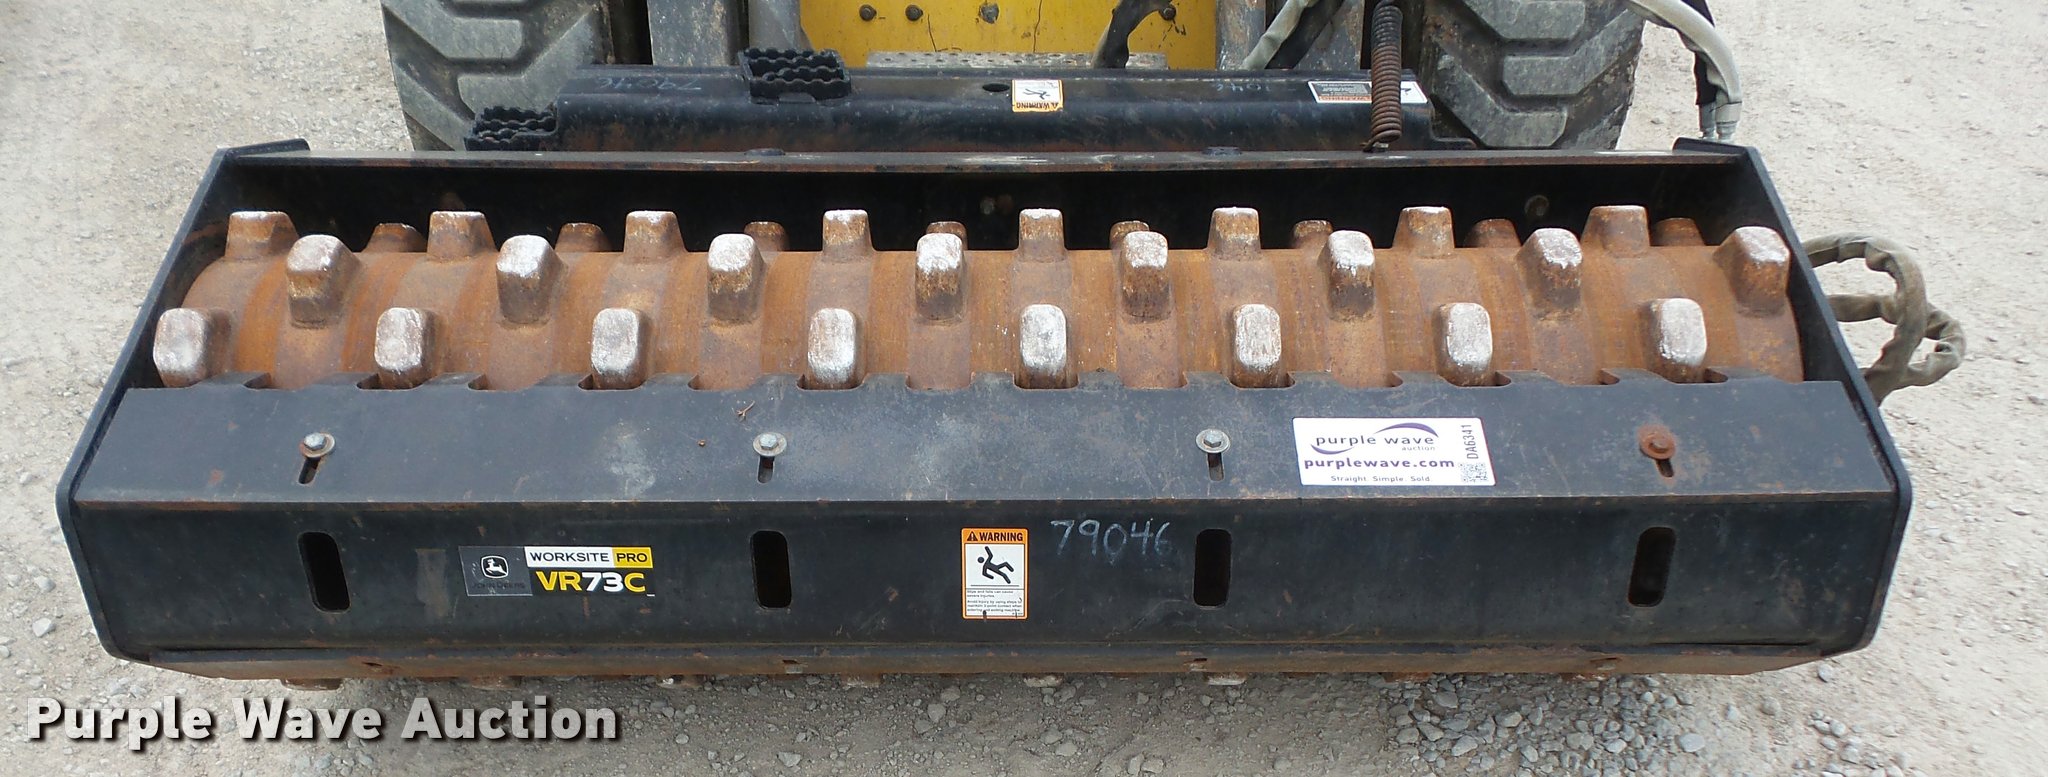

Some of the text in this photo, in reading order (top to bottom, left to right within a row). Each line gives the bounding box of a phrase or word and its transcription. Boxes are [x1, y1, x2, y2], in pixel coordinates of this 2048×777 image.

[1016, 102, 1051, 110] WARNING
[1316, 435, 1434, 446] purple wave
[1461, 424, 1479, 460] DA6341
[1304, 457, 1455, 470] purplewave.com
[979, 532, 1024, 542] WARNING
[1050, 518, 1171, 557] 79046
[530, 552, 648, 562] WORKSITE PRO
[535, 570, 646, 592] VR73C
